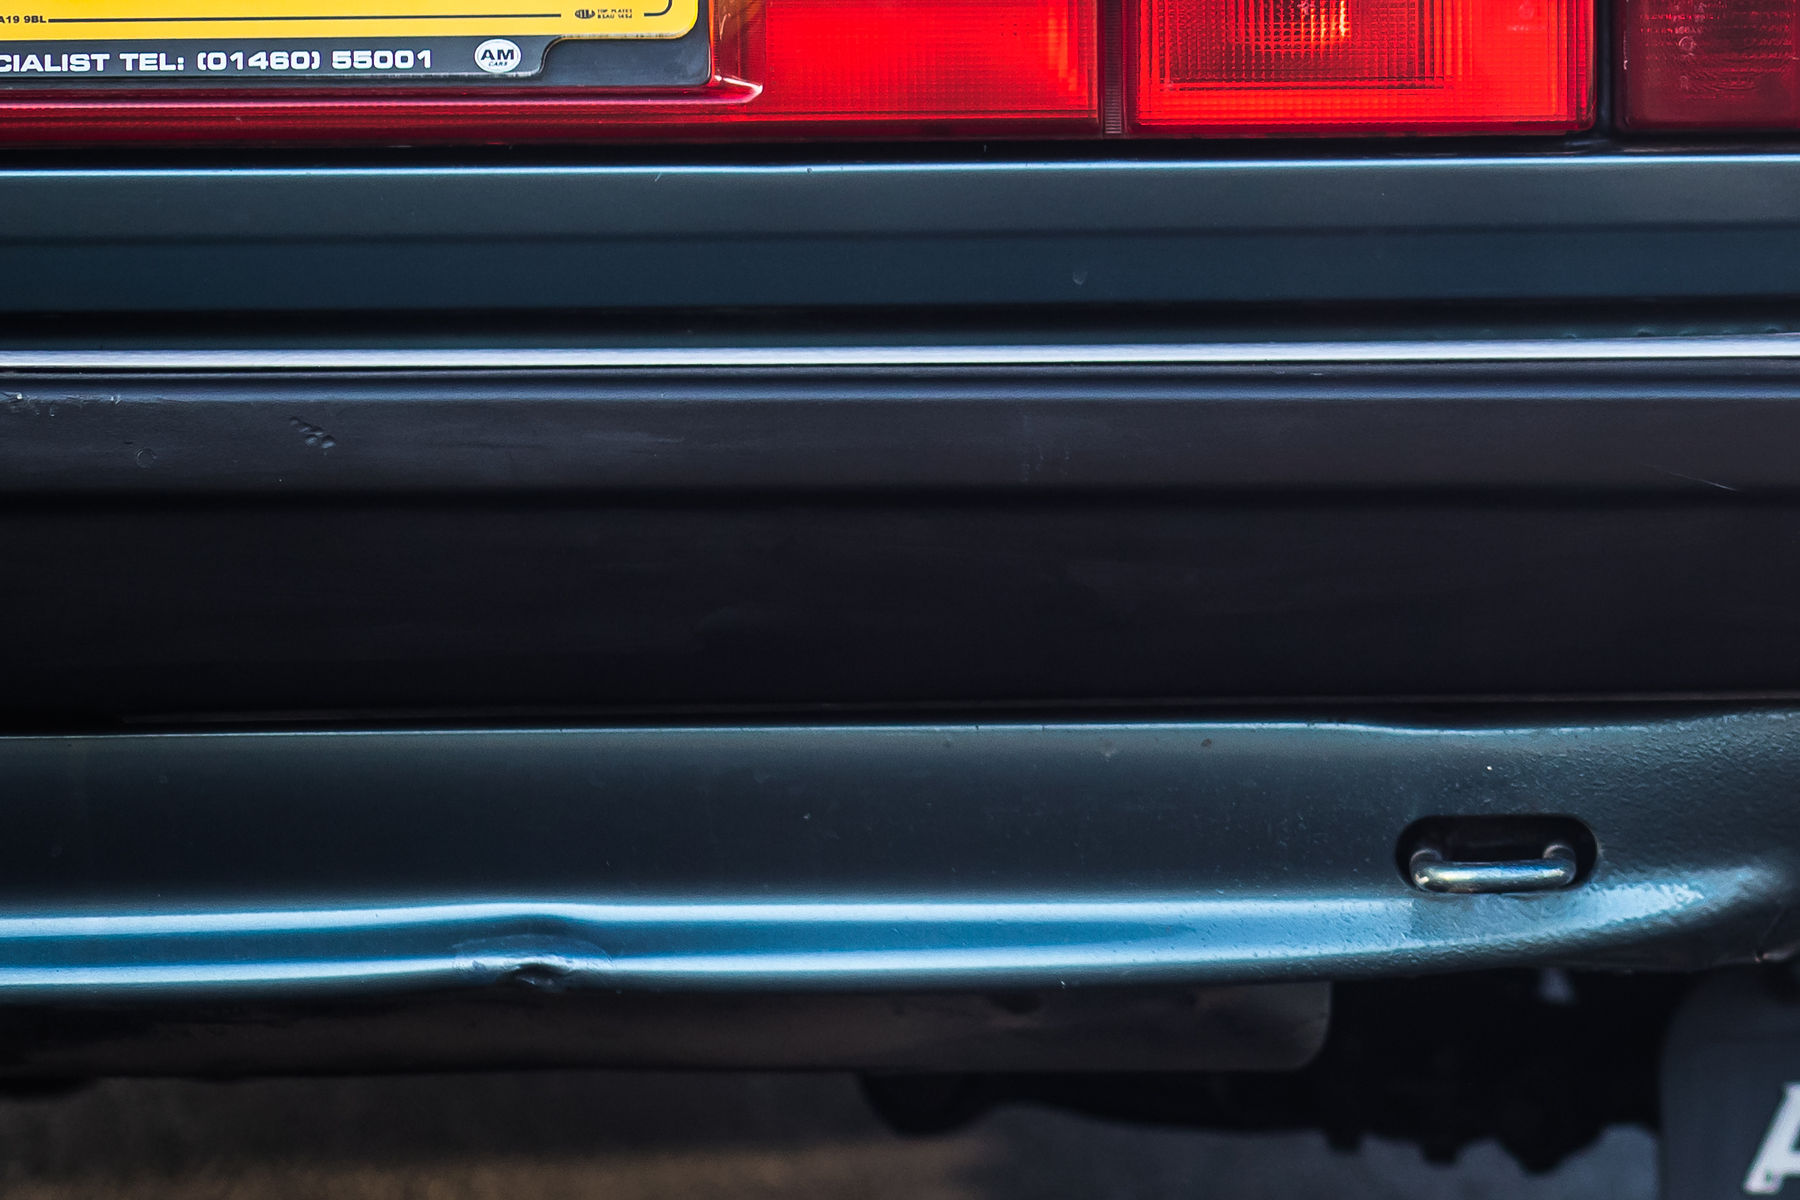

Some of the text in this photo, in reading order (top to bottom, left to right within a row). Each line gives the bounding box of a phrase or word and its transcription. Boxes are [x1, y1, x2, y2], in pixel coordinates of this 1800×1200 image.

[23, 15, 47, 24] 9BL
[480, 49, 515, 61] AM
[0, 50, 433, 73] CIALIST TEL: (01460) 55001
